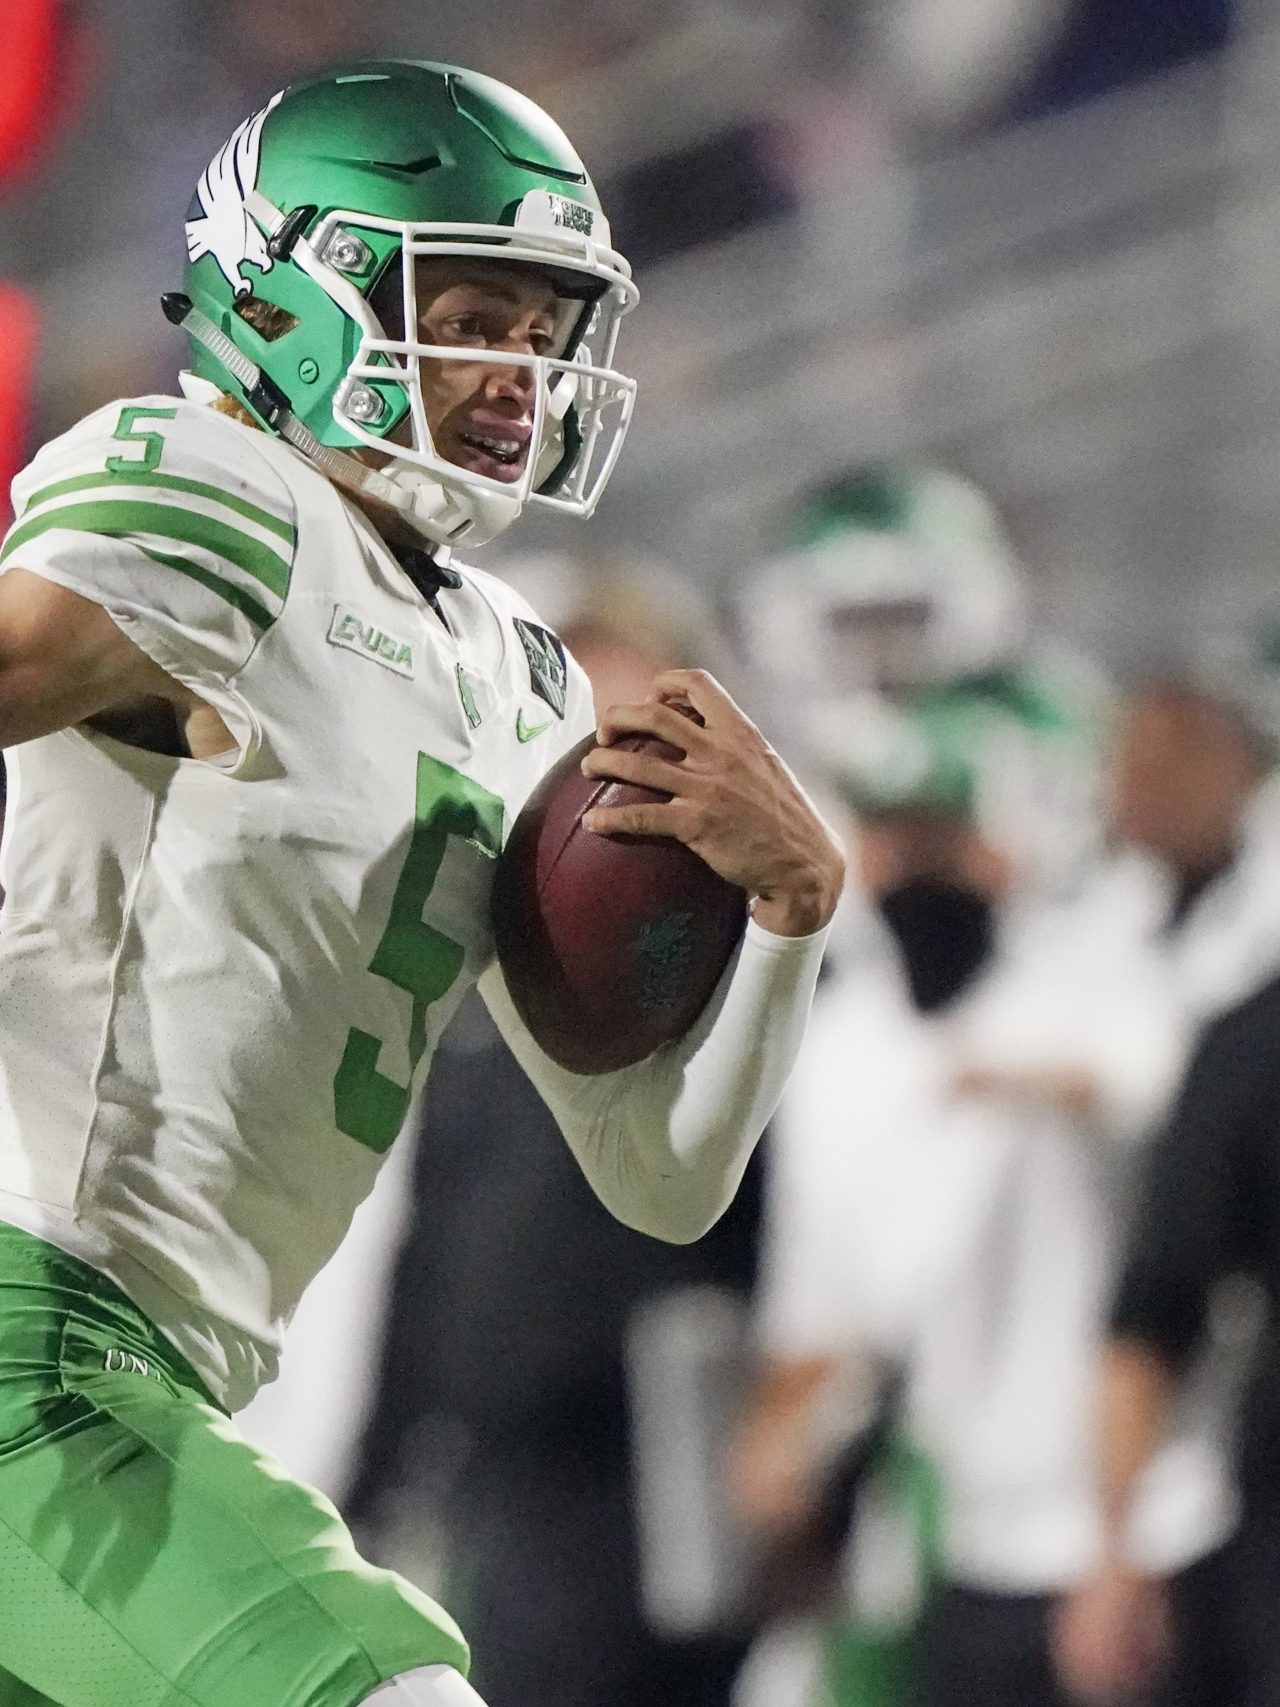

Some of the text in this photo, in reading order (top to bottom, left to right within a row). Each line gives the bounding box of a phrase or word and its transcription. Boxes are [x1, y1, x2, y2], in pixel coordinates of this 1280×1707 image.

[105, 406, 178, 473] 5
[333, 751, 505, 1154] 5
[104, 1347, 161, 1383] UN
